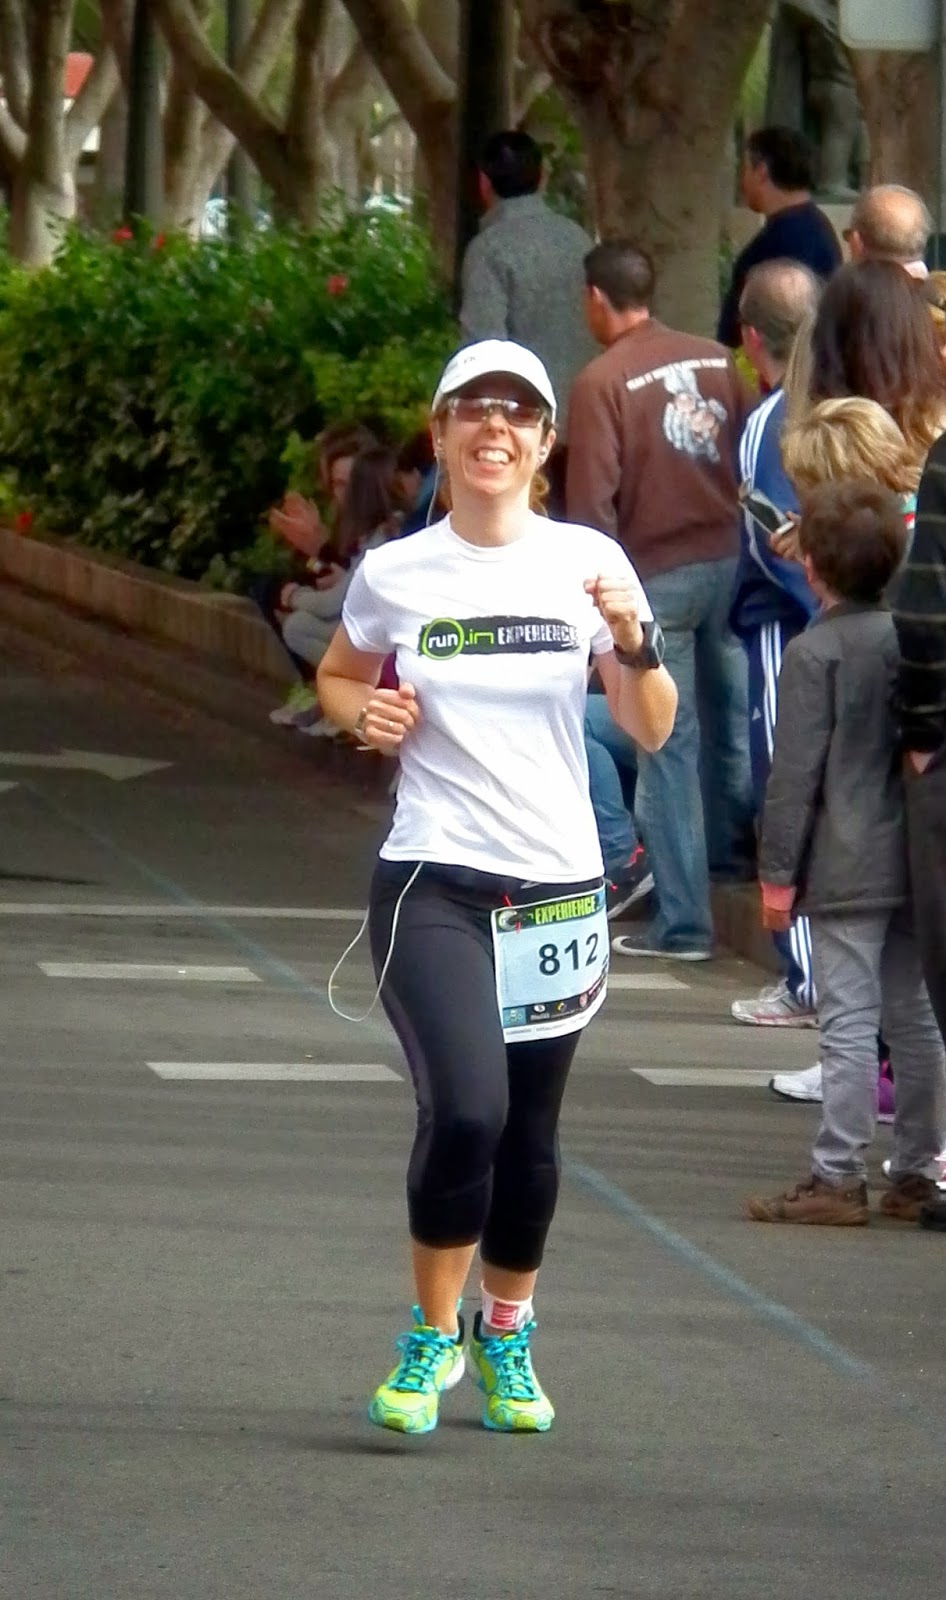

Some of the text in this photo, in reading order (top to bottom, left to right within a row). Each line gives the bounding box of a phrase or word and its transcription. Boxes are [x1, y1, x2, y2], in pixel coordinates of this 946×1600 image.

[497, 624, 577, 645] EXPERIENCE
[534, 895, 596, 925] EXPERIENCE
[538, 932, 599, 976] 812
